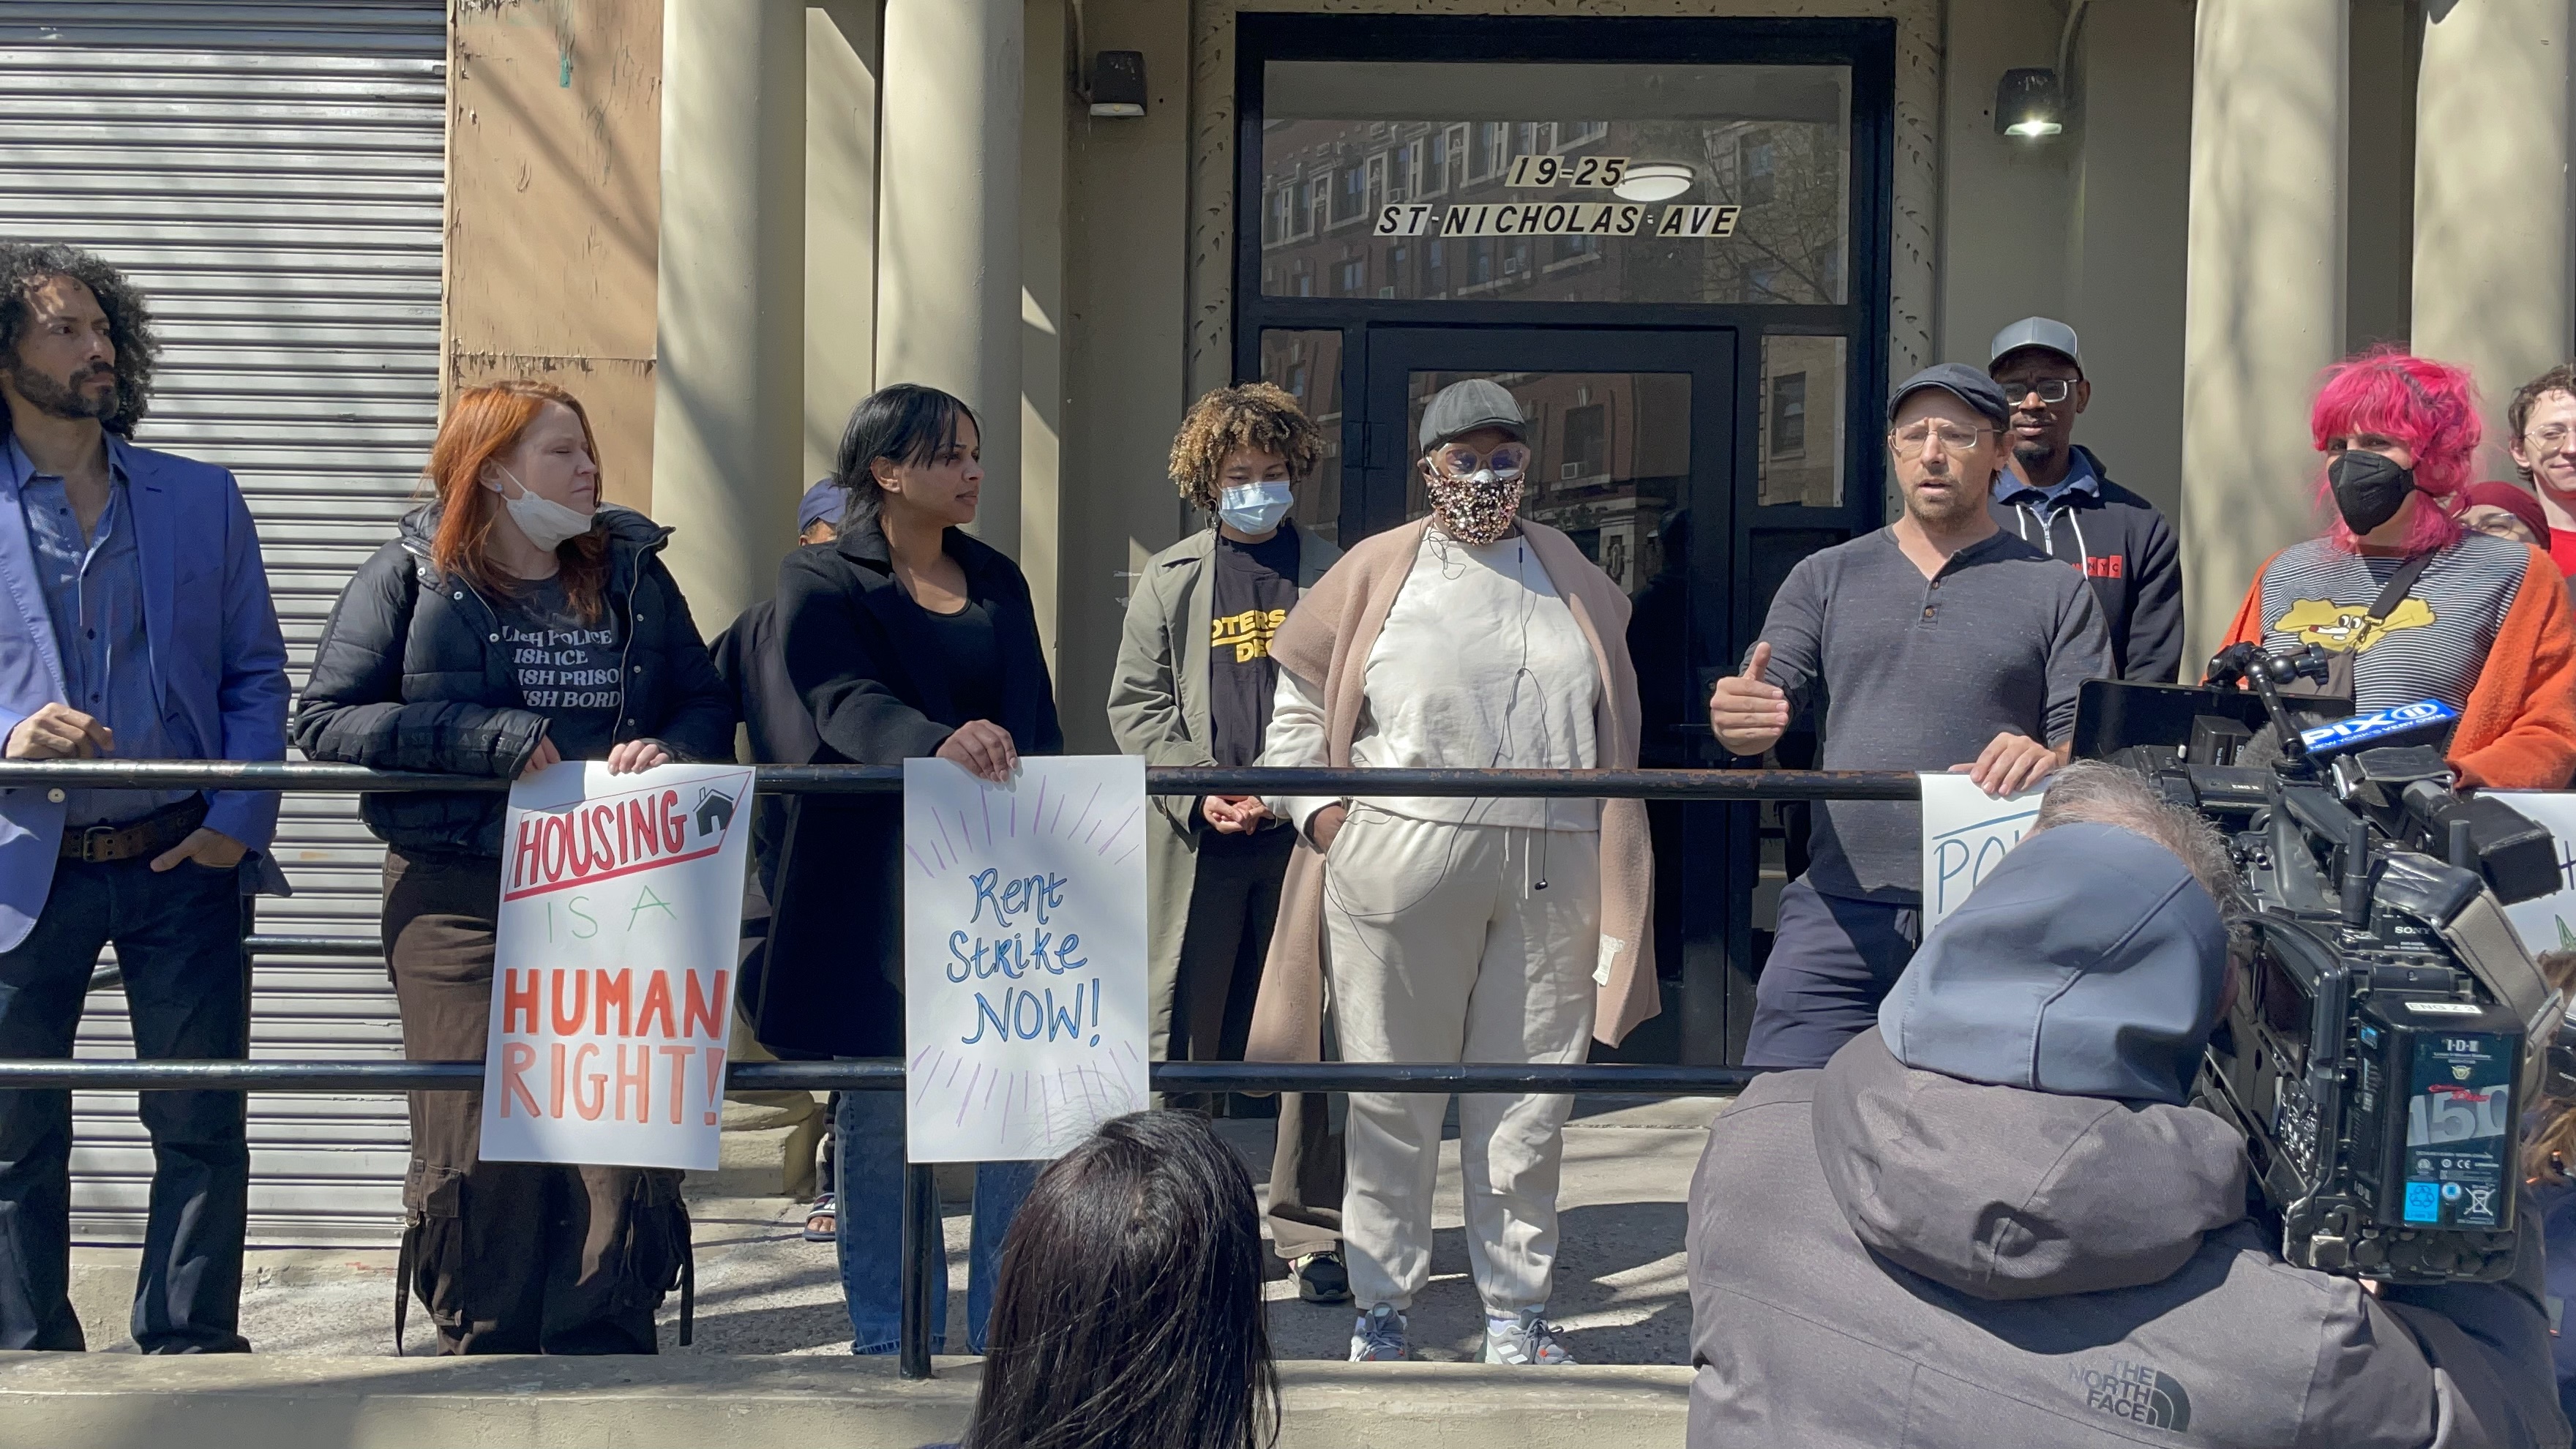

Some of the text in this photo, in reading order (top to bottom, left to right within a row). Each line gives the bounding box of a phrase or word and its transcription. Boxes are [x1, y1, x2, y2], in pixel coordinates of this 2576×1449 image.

[1514, 157, 1625, 186] 19-25
[1444, 204, 1639, 234] NICHOLAS
[1660, 206, 1734, 234] AVE
[547, 629, 612, 646] POLICE
[554, 649, 588, 666] ICE
[2301, 713, 2398, 746] PIX
[2310, 739, 2337, 750] NEW
[2381, 720, 2414, 731] VERY
[2415, 714, 2446, 723] OWN
[514, 790, 688, 888] HOUSING
[1933, 829, 2020, 915] PO
[547, 885, 678, 943] IS A
[969, 867, 1067, 927] Rent
[2394, 926, 2431, 935] SONY
[502, 967, 730, 1041] HUMAN
[961, 978, 1101, 1047] NOW!
[500, 1041, 726, 1127] RIGHT!
[2457, 1159, 2471, 1169] CE
[2068, 1361, 2152, 1404] NORTH
[2108, 1355, 2155, 1386] THE
[2086, 1388, 2148, 1422] FACE
